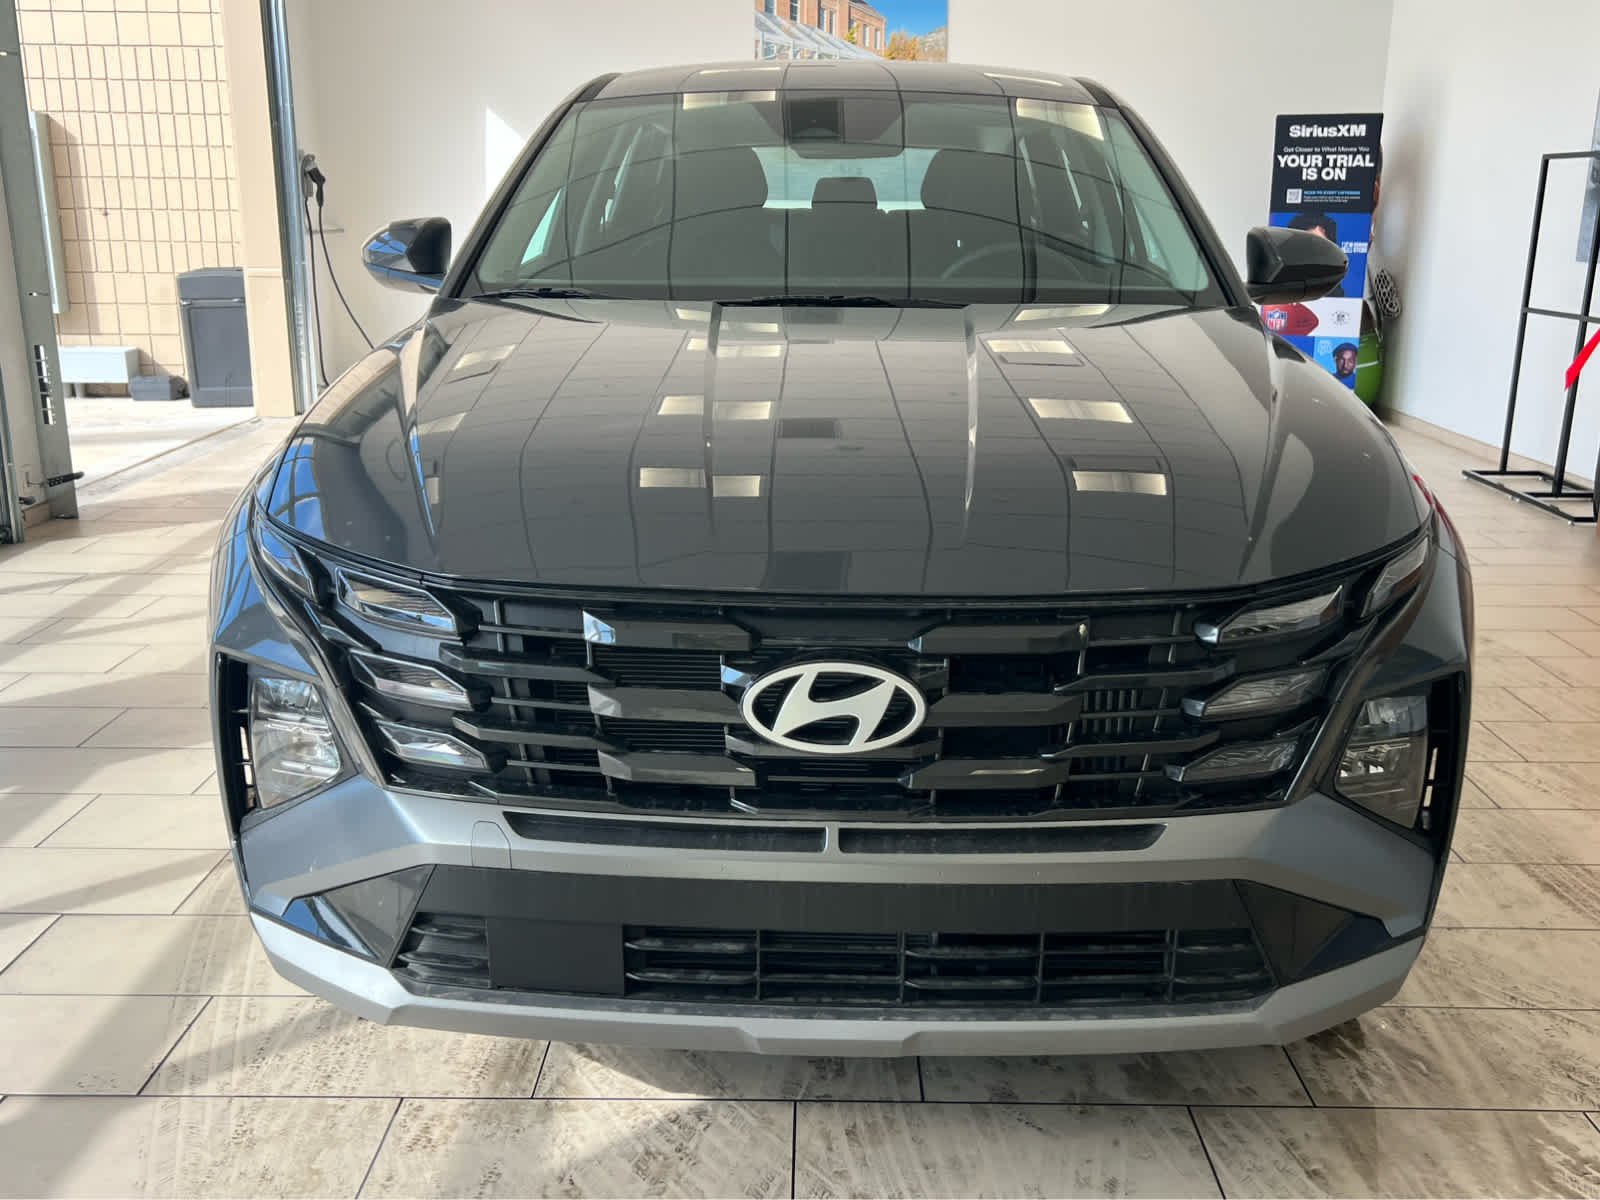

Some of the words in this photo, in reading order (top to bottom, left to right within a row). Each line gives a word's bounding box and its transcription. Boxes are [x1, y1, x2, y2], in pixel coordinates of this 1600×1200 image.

[1289, 124, 1367, 138] SiriusXM
[1277, 154, 1322, 168] YOUR
[1326, 154, 1374, 168] TRIAL
[1302, 167, 1318, 180] IS
[1321, 167, 1347, 180] ON
